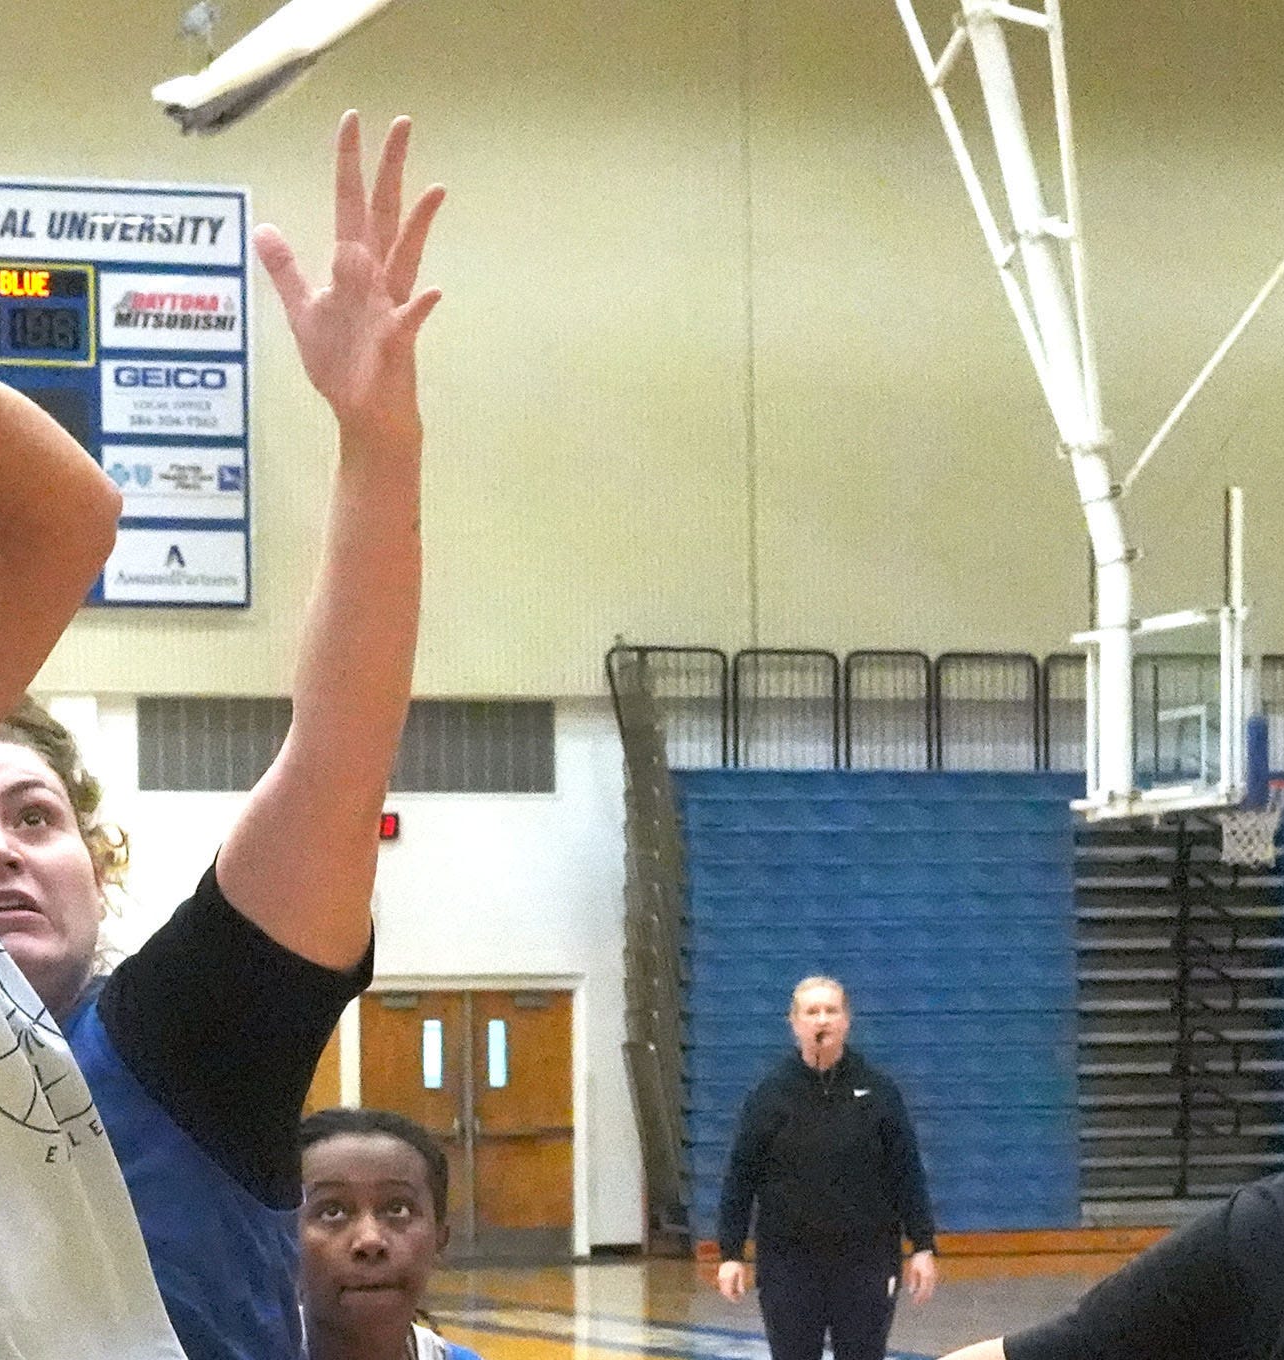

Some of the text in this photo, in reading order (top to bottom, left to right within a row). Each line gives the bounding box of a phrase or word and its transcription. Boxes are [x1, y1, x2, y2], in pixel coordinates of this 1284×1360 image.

[46, 208, 225, 246] UNIVERSITY
[114, 311, 237, 332] MITSUBISHI
[114, 366, 227, 389] GEICO
